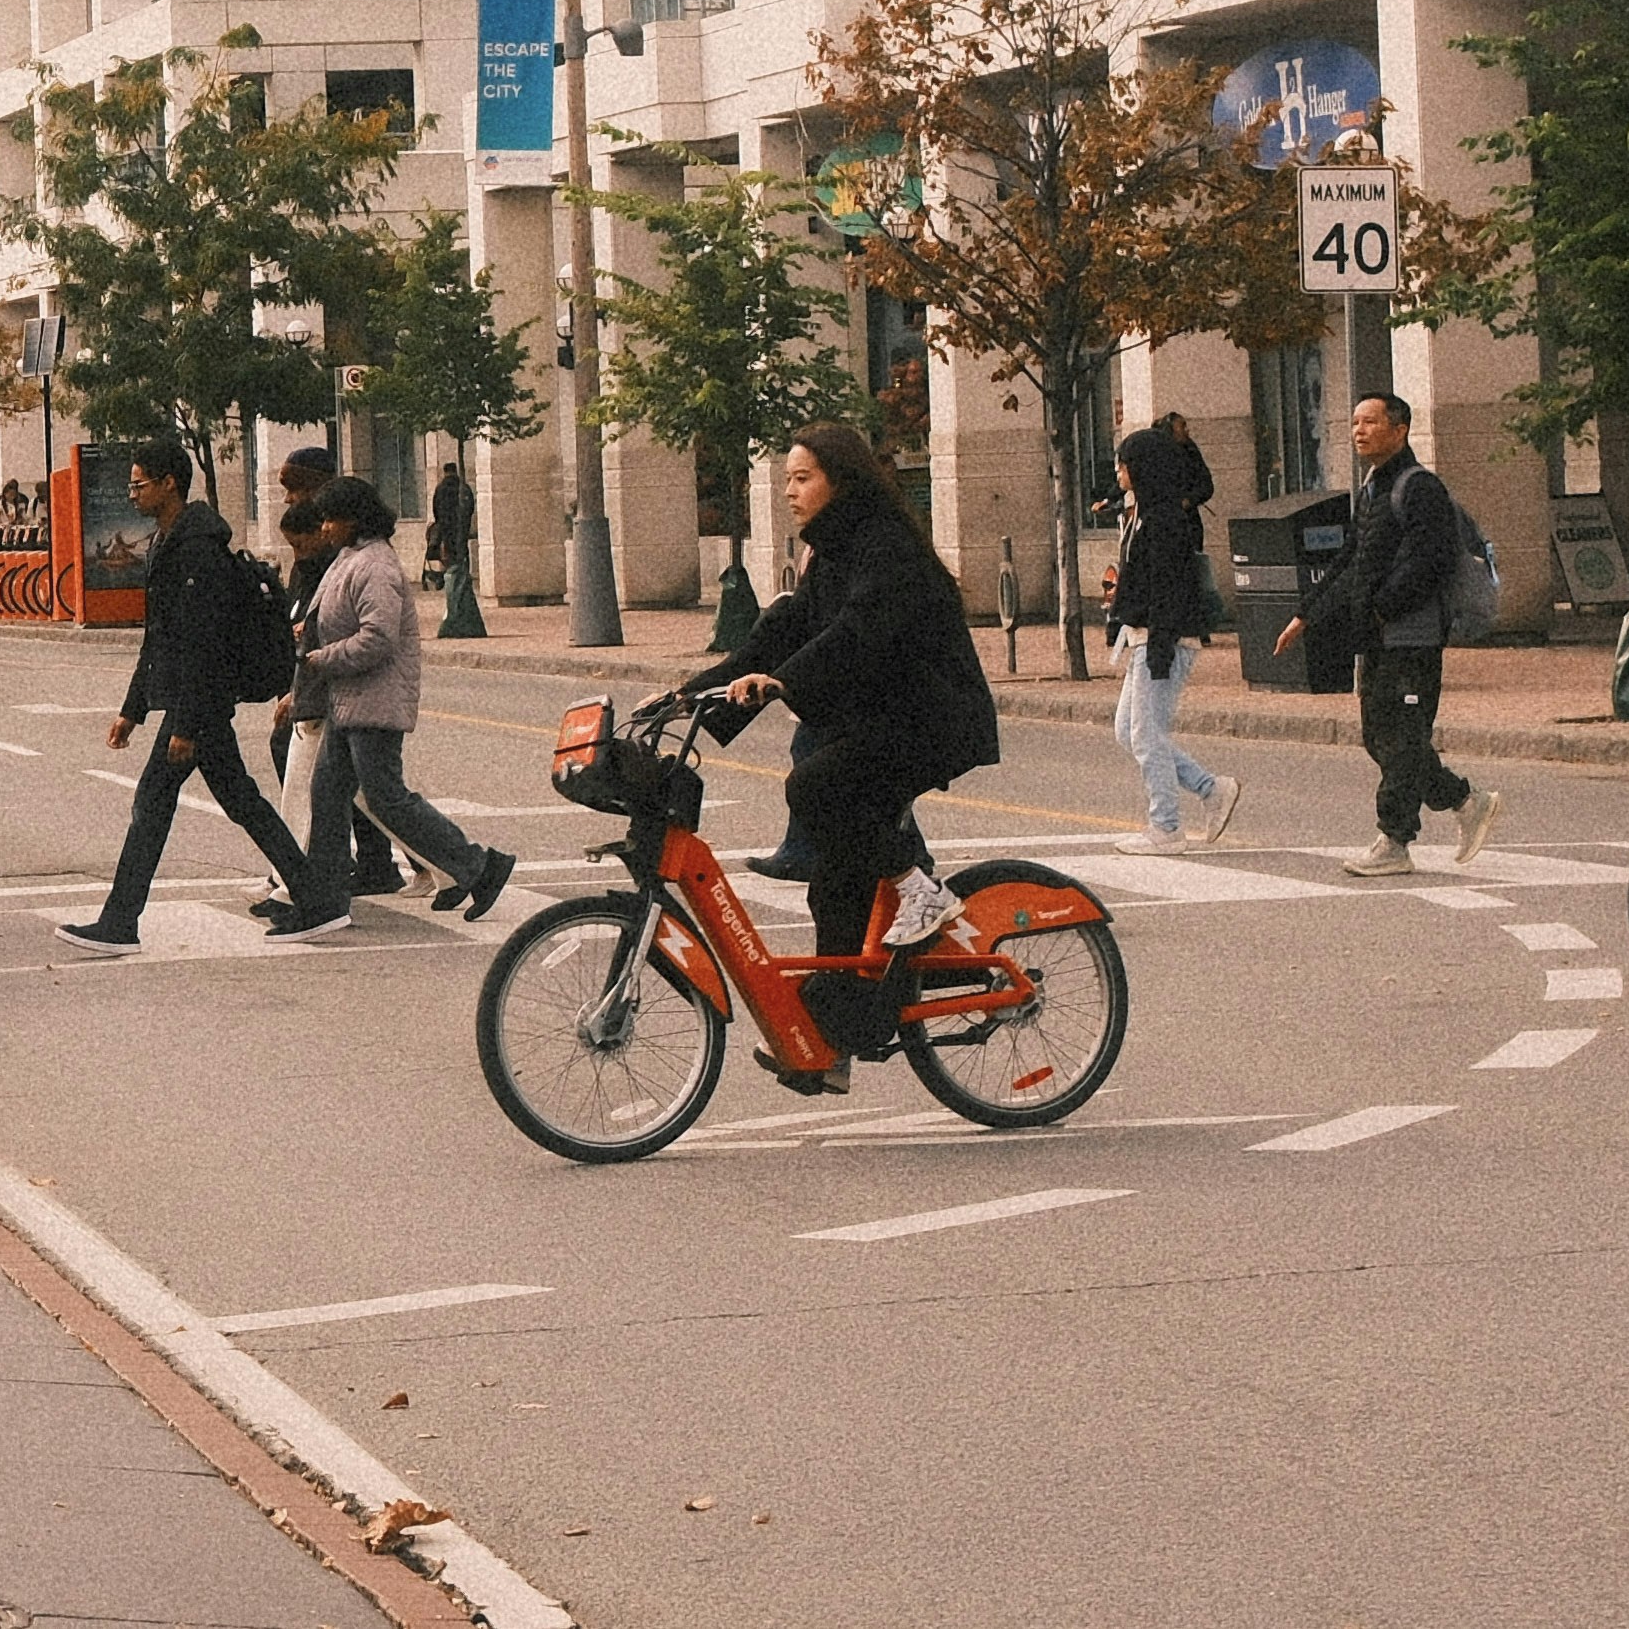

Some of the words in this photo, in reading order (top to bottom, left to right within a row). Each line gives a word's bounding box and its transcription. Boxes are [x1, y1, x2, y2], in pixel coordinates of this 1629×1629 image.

[484, 42, 550, 57] ESCAPE
[484, 63, 517, 78] THE
[483, 84, 522, 98] CITY
[1307, 83, 1347, 125] Hanger
[1311, 184, 1385, 202] MAXIMUM
[1312, 222, 1389, 275] 40
[710, 877, 762, 963] Tangerine
